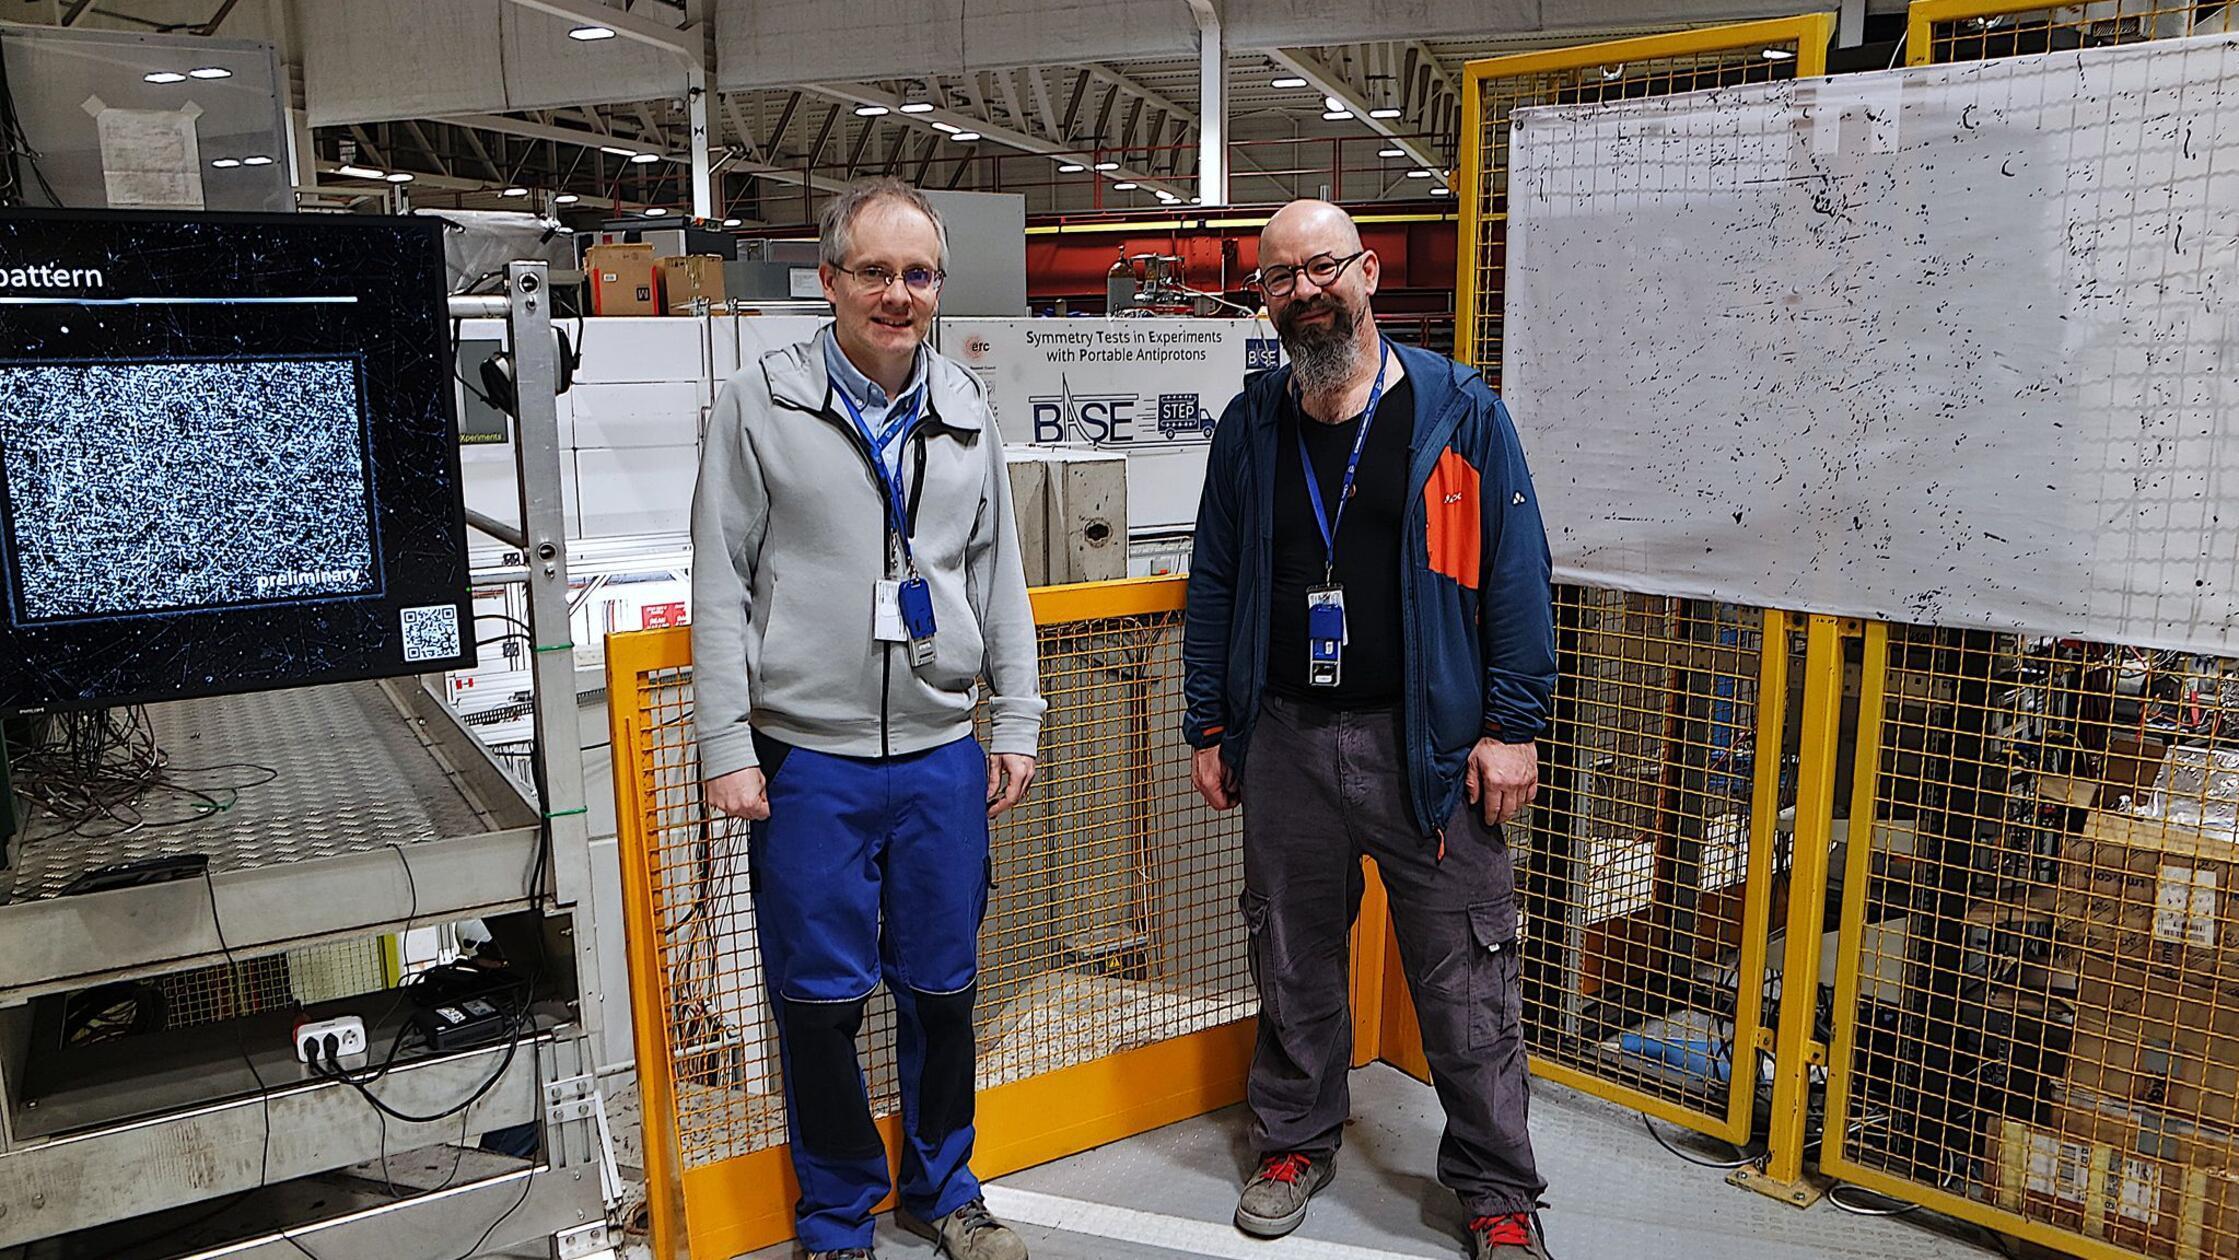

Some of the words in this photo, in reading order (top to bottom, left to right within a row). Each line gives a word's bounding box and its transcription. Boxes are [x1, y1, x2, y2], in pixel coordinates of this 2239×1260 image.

[972, 342, 990, 352] erc
[1026, 330, 1094, 347] Symmetry
[1098, 331, 1131, 344] Tests
[1134, 330, 1145, 344] in
[1149, 330, 1222, 347] Experiments
[1046, 347, 1075, 362] with
[1079, 348, 1133, 362] Portable
[1136, 348, 1207, 364] Antiprotons
[1033, 373, 1136, 443] BASE
[1162, 403, 1196, 420] STEP
[257, 567, 360, 593] preliminary
